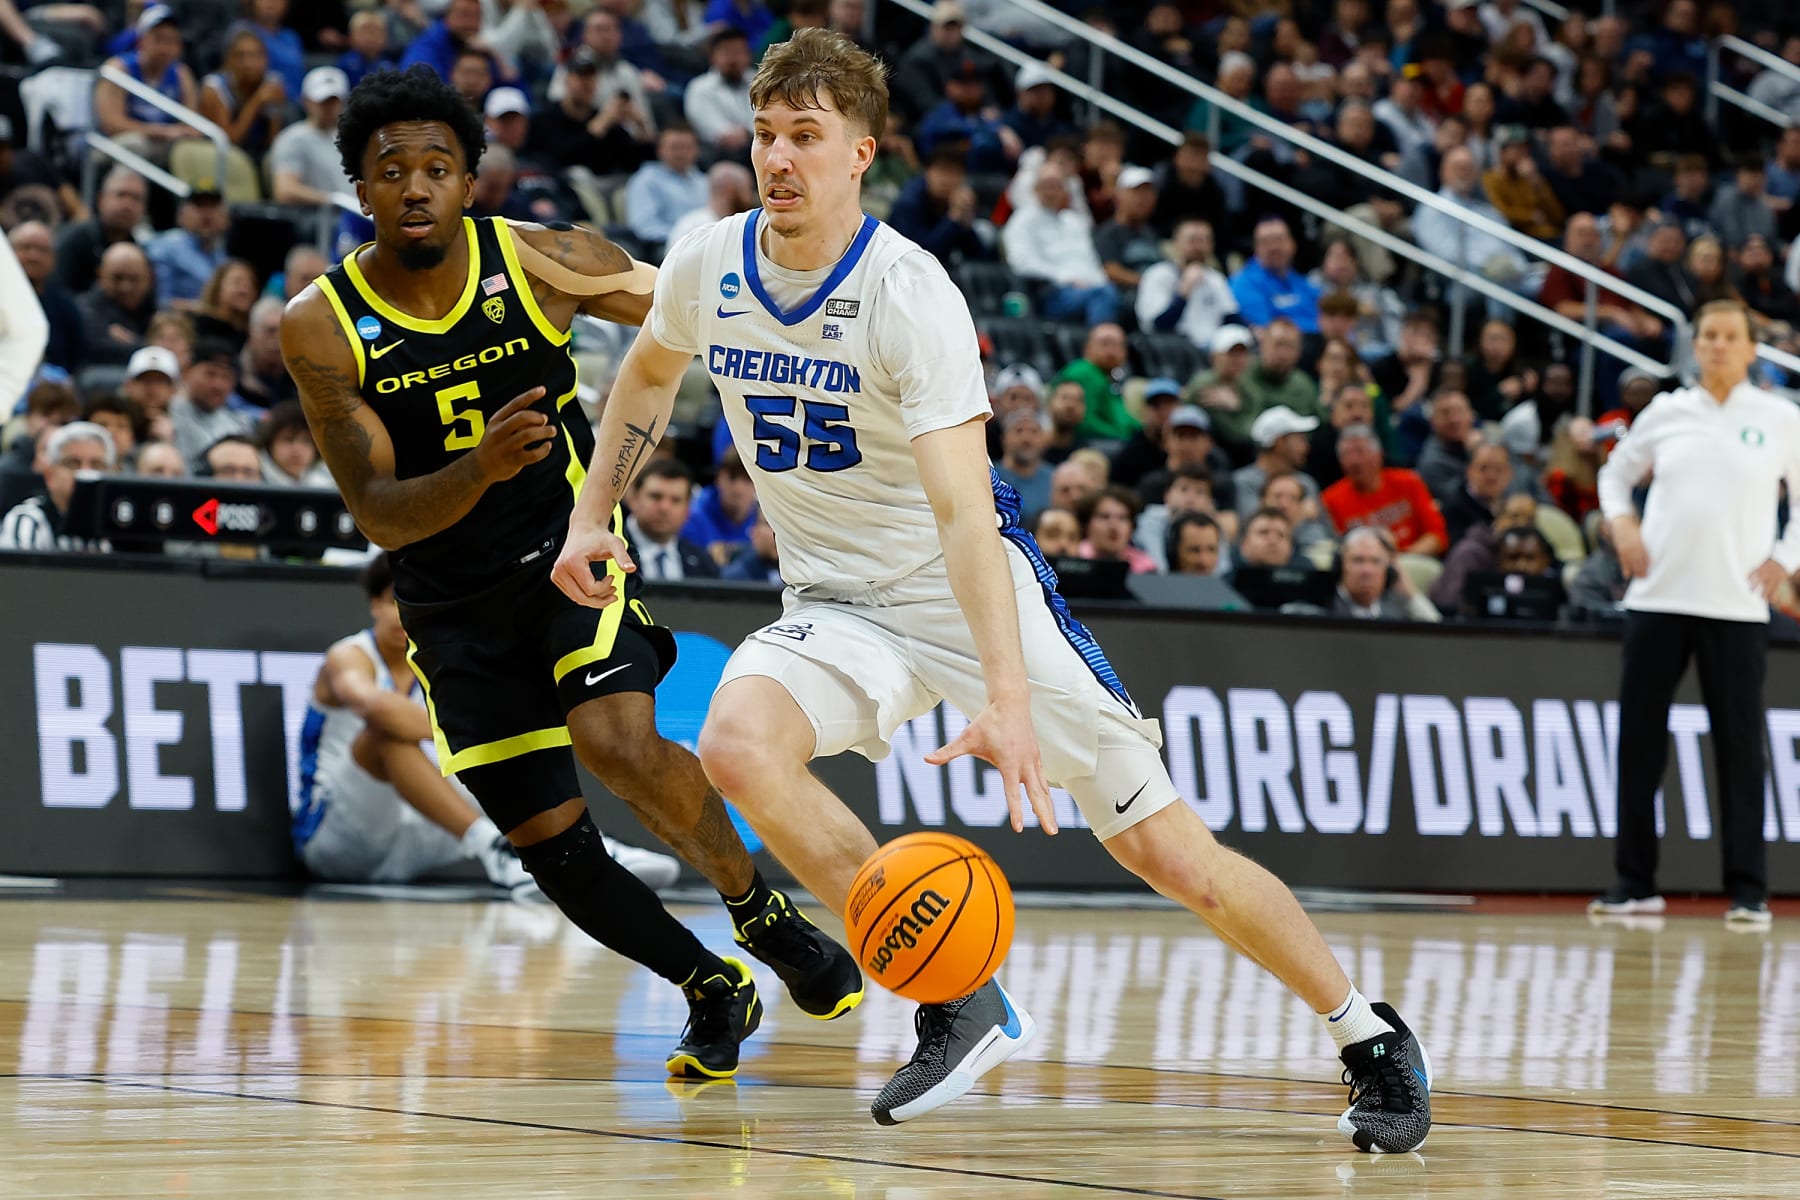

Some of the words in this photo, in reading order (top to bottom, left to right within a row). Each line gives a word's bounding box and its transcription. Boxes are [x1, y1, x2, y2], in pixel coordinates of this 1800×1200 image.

[375, 337, 530, 394] OREGON
[708, 344, 862, 394] CREIGHTON
[434, 380, 486, 452] 5
[742, 394, 863, 473] 55
[868, 888, 951, 976] Wilson
